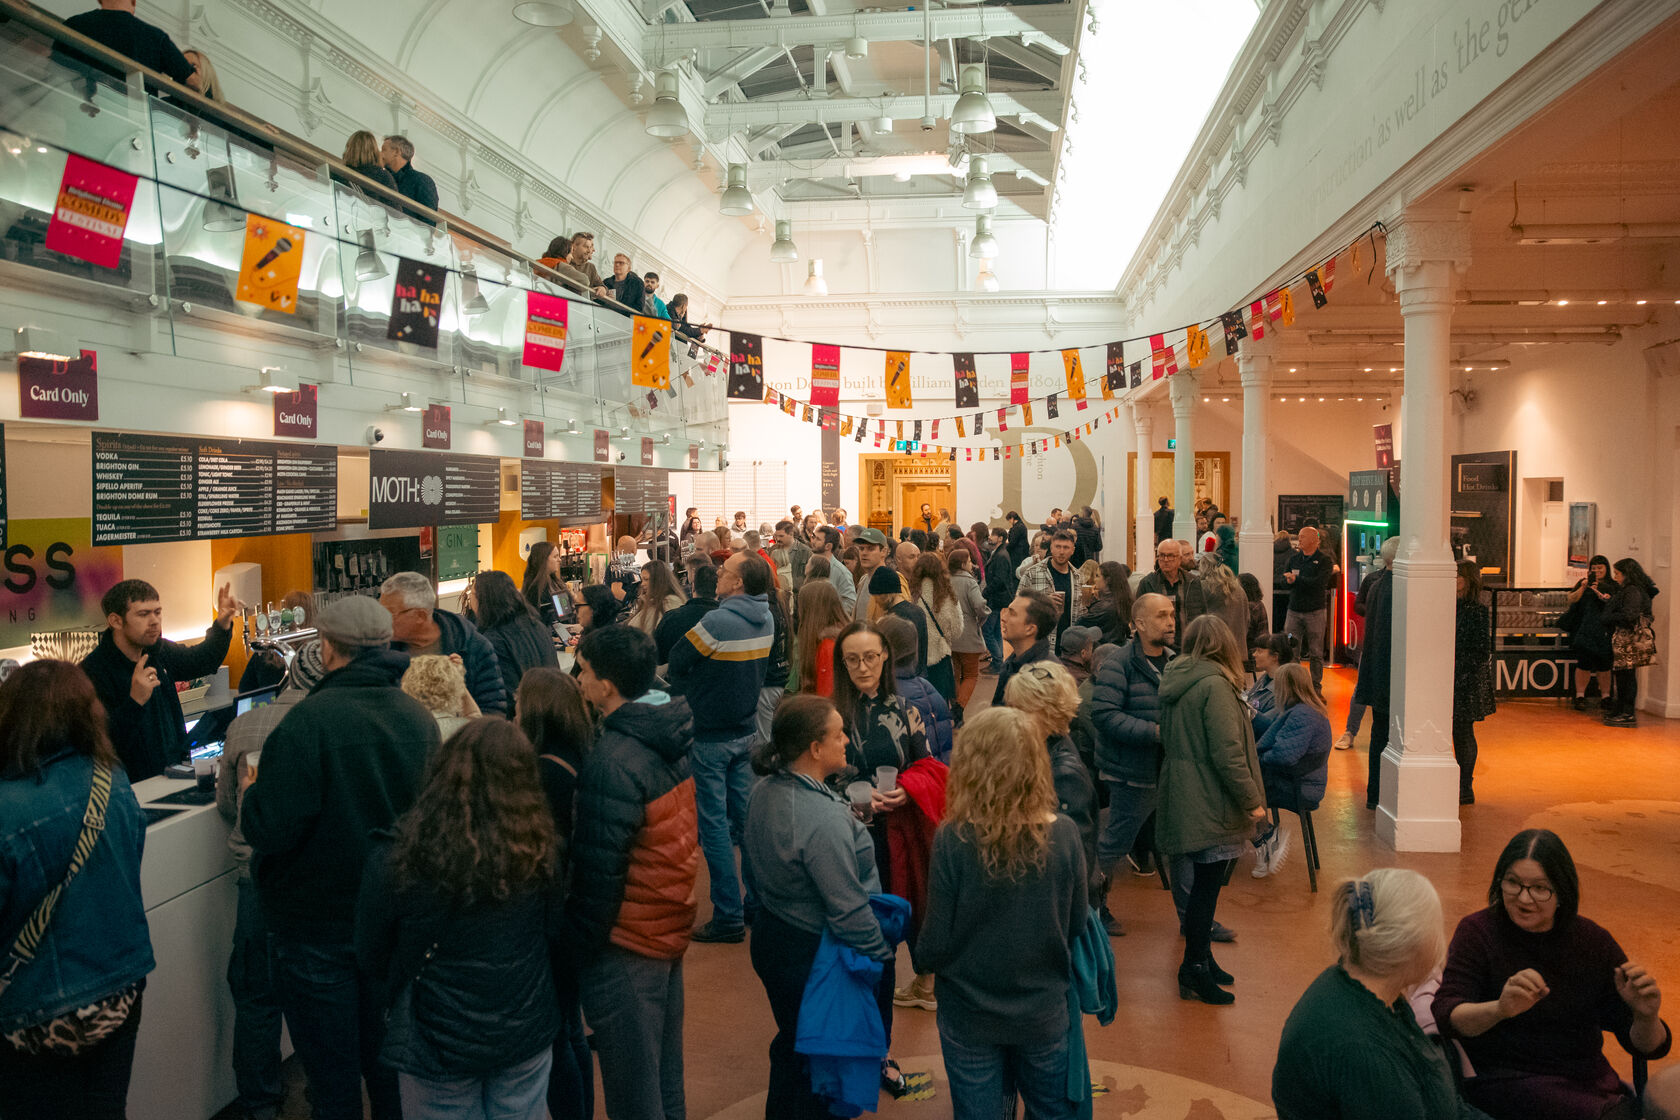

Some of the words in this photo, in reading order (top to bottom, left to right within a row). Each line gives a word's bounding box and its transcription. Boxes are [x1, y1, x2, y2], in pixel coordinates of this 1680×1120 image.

[1394, 63, 1427, 132] well
[1431, 60, 1449, 99] as
[60, 195, 121, 224] COMEDY
[60, 208, 120, 237] FESTIVAL
[395, 283, 417, 298] ha
[420, 288, 440, 305] ha
[400, 298, 422, 313] ha
[730, 352, 746, 364] ha
[747, 353, 762, 366] ha
[735, 363, 750, 375] ha
[910, 375, 952, 389] illiam
[30, 384, 59, 402] Card
[61, 387, 89, 407] Only
[280, 411, 296, 425] Card
[296, 413, 313, 429] Only
[426, 428, 437, 440] Card
[437, 430, 448, 442] Only
[96, 452, 118, 460] VODKA
[96, 462, 127, 470] BRIGHTON
[127, 462, 139, 470] GIN
[1463, 474, 1479, 482] Food
[96, 513, 120, 521] TEQUILA
[96, 523, 115, 531] TUACA
[446, 533, 463, 549] GIN
